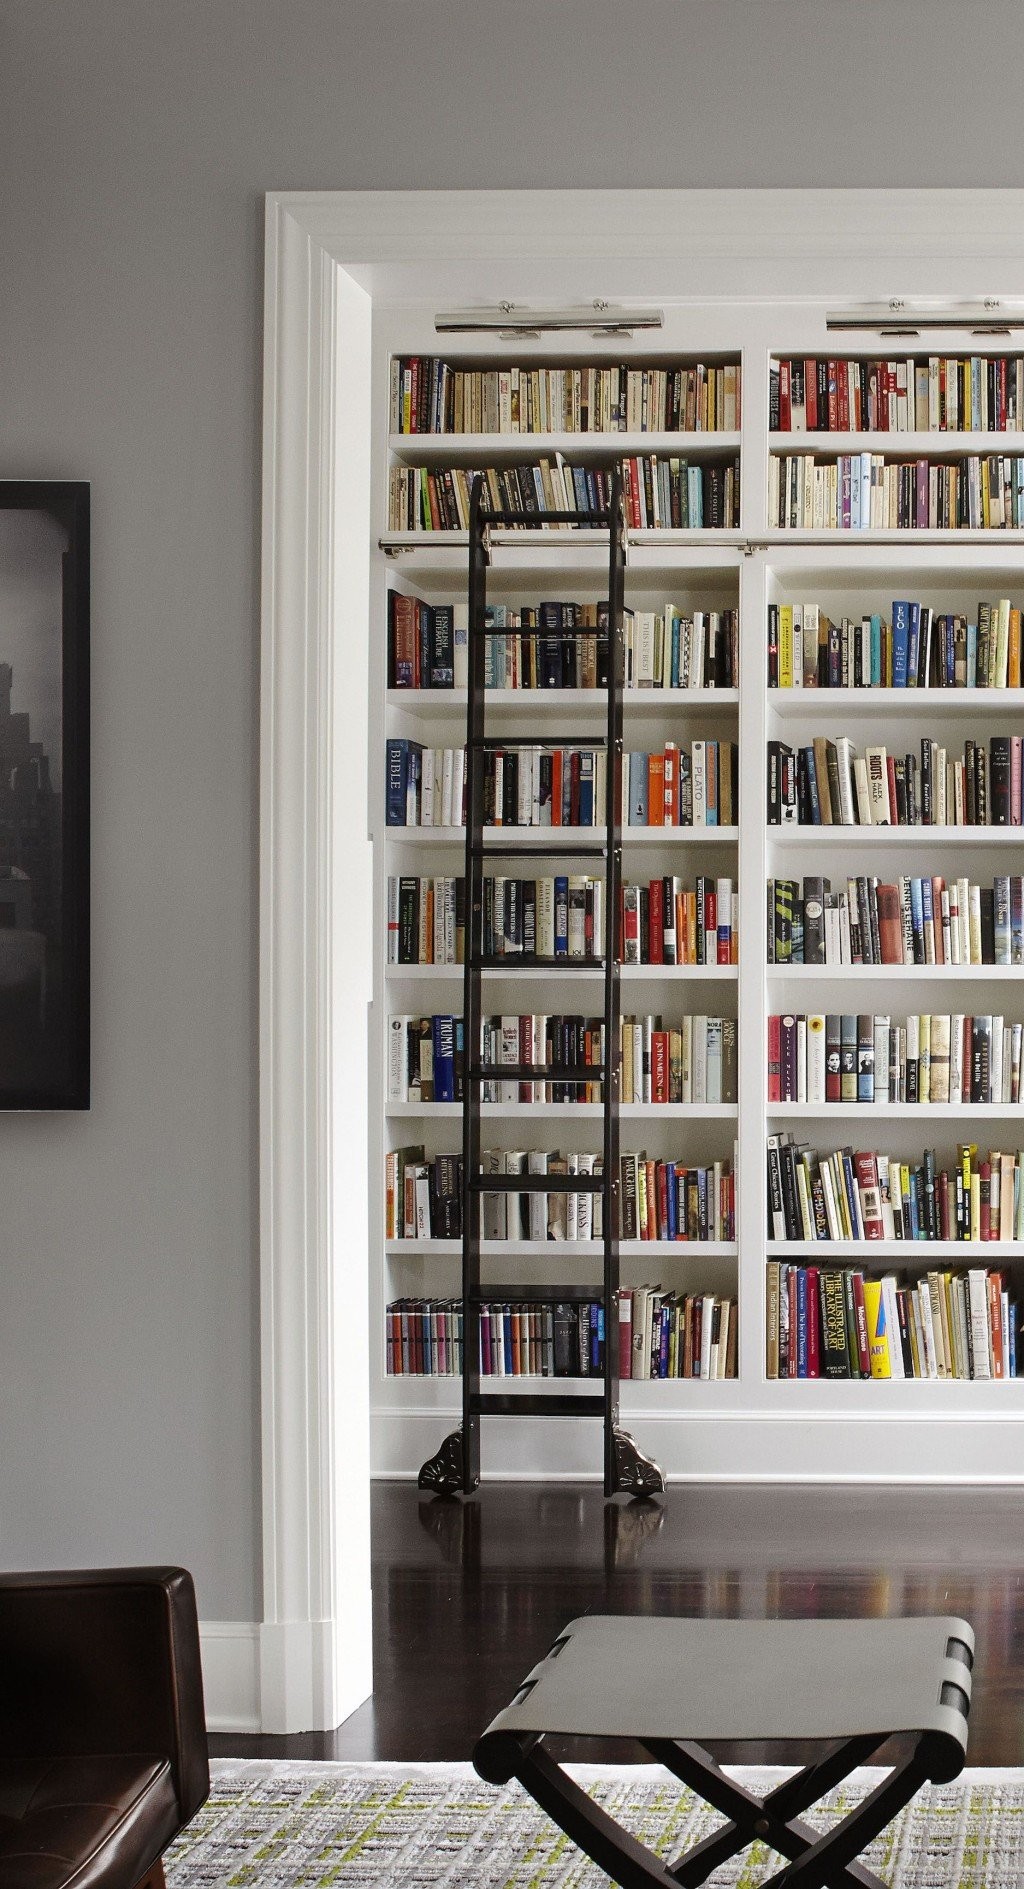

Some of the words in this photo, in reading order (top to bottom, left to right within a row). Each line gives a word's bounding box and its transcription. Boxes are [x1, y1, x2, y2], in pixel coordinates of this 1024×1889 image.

[771, 379, 779, 412] MIDDLESEX
[980, 607, 989, 620] AMY
[980, 622, 989, 634] TAN
[390, 750, 401, 790] BIBLE
[869, 755, 883, 781] ROOTS
[695, 767, 703, 801] PLATO
[903, 876, 912, 912] DENNIS
[559, 905, 567, 936] ELEANOR
[906, 914, 914, 952] LEHANE
[440, 1018, 453, 1057] TRUMAN
[655, 1043, 664, 1062] JOHN
[656, 1063, 664, 1087] MILTON
[770, 1168, 778, 1190] Chicago
[963, 1157, 971, 1190] WATCHMEN
[578, 1192, 587, 1229] ICKENS
[825, 1274, 836, 1314] LIBRARY
[833, 1273, 842, 1292] THE
[580, 1318, 589, 1346] History
[827, 1316, 836, 1327] OF
[837, 1293, 846, 1350] ILLUSTRATED
[828, 1328, 838, 1350] ART
[581, 1354, 589, 1371] Jazz
